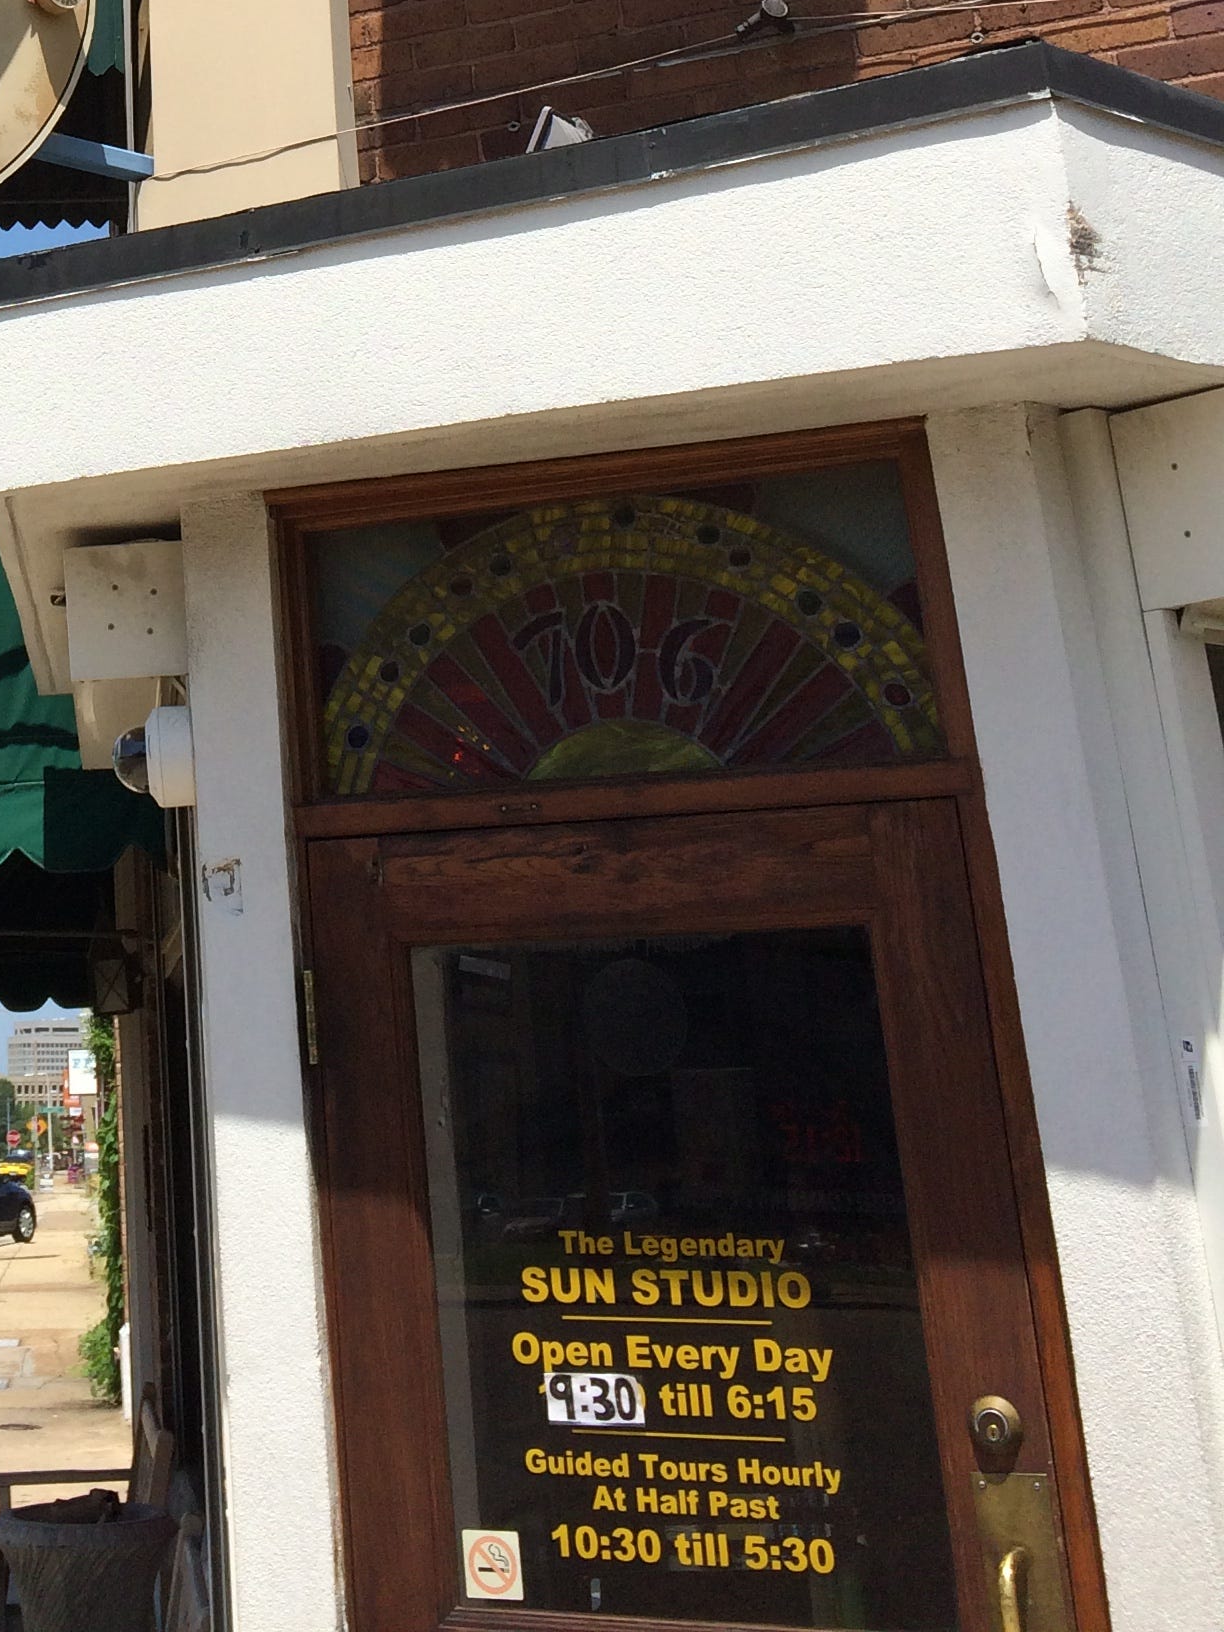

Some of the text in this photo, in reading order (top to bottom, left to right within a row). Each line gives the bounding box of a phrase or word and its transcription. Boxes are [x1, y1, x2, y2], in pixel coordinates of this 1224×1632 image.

[512, 600, 734, 708] 706
[559, 1231, 784, 1264] The Legendary
[521, 1267, 812, 1308] SUN STUDIO
[512, 1332, 833, 1382] Open Every Day
[549, 1374, 817, 1422] 9:30 till 6:15
[525, 1449, 841, 1494] Guided Tours Hourly
[592, 1486, 780, 1519] At Half Past
[551, 1525, 835, 1574] 10:30 till 5:30
